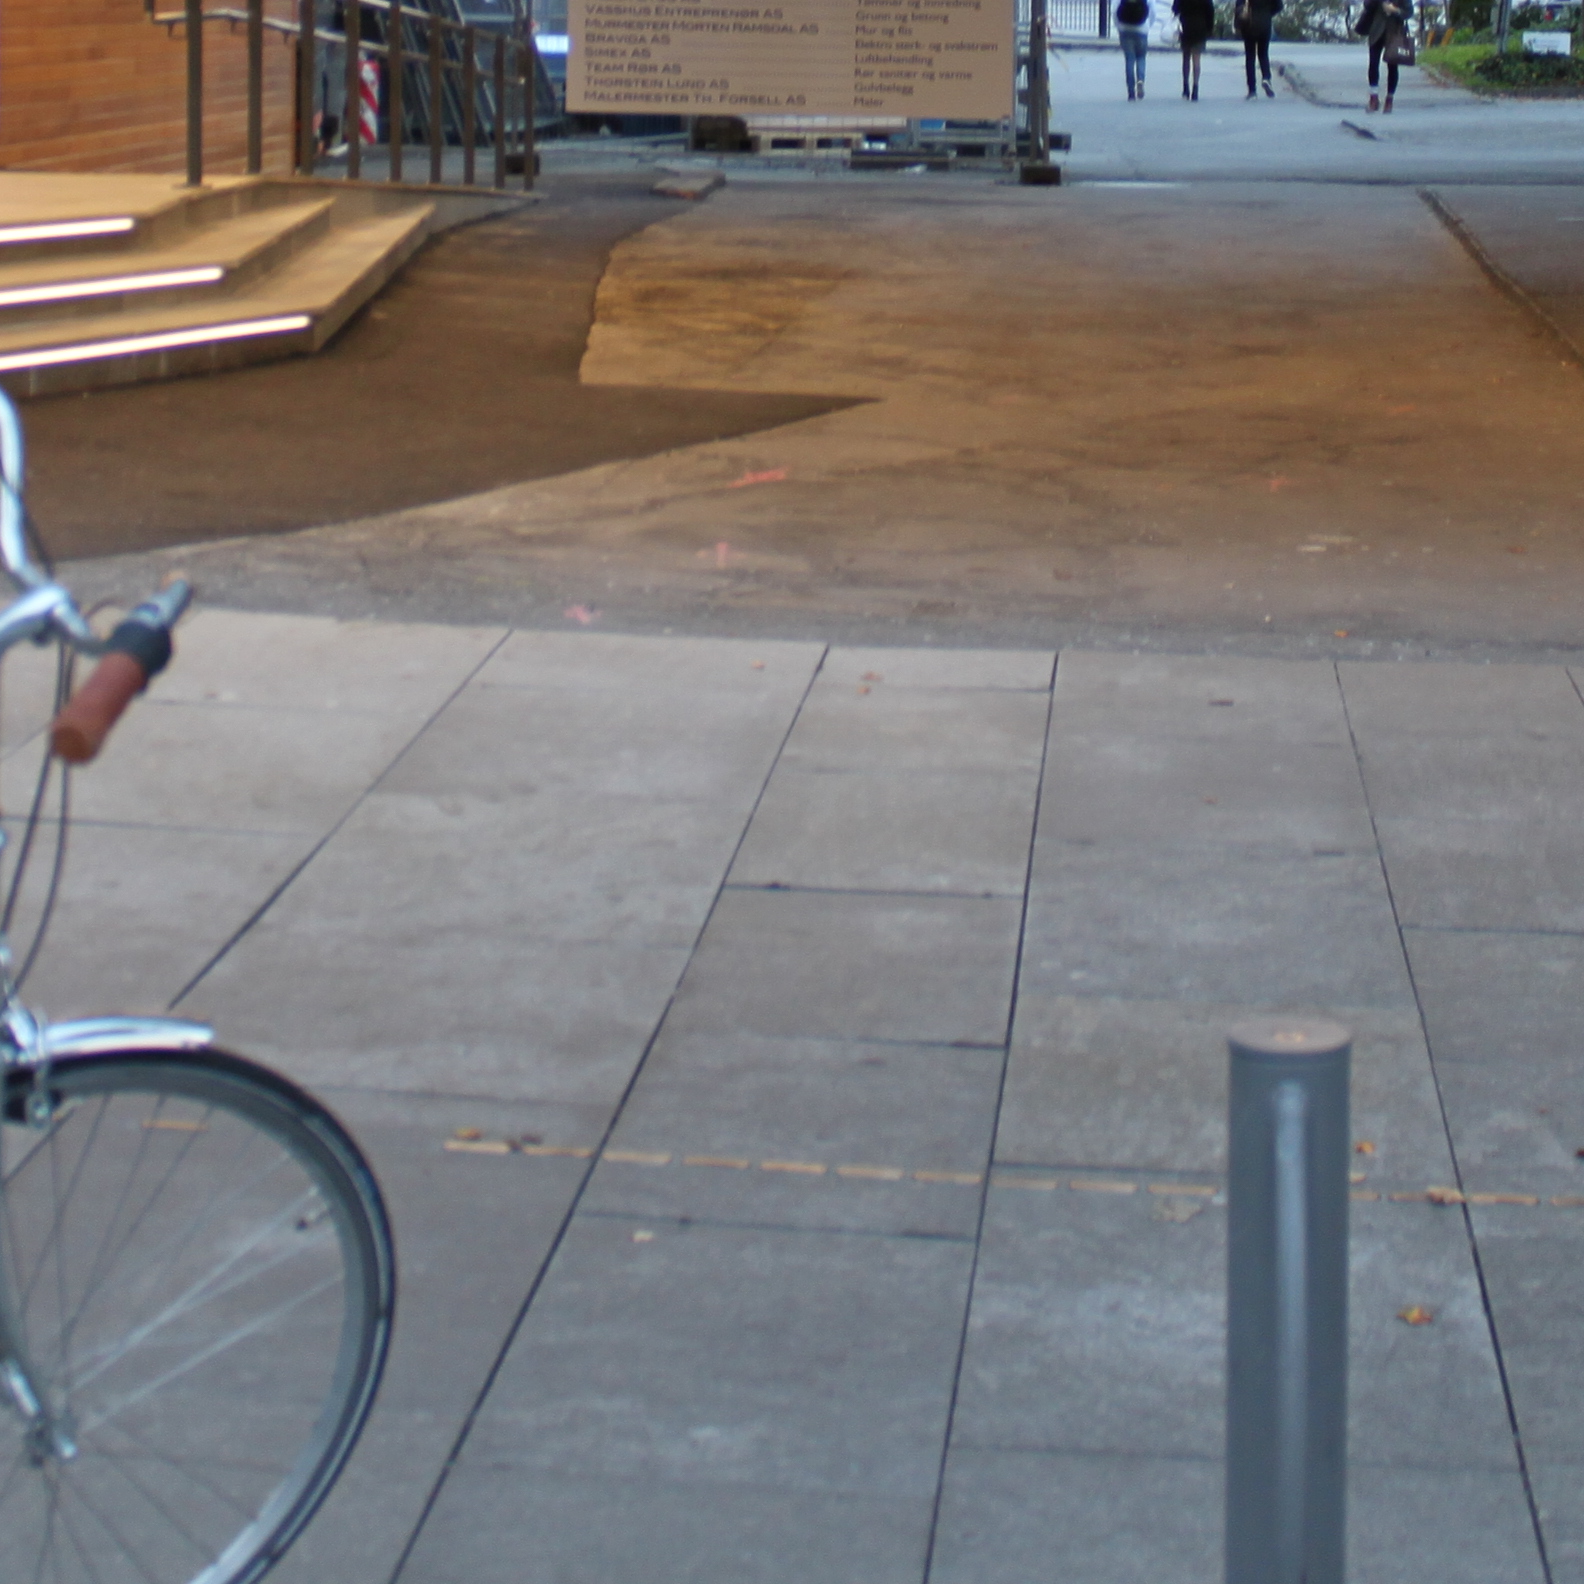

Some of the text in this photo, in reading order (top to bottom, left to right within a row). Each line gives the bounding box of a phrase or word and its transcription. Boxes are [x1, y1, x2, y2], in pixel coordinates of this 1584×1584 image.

[907, 0, 920, 9] og
[763, 8, 783, 19] AS
[895, 14, 908, 23] og
[799, 24, 819, 35] AS
[881, 27, 895, 37] og
[650, 35, 671, 45] AS
[929, 43, 942, 52] og
[631, 48, 651, 58] AS
[585, 62, 624, 72] TEAM
[662, 63, 682, 74] AS
[922, 72, 935, 81] og
[709, 79, 729, 90] AS
[786, 95, 806, 106] AS
